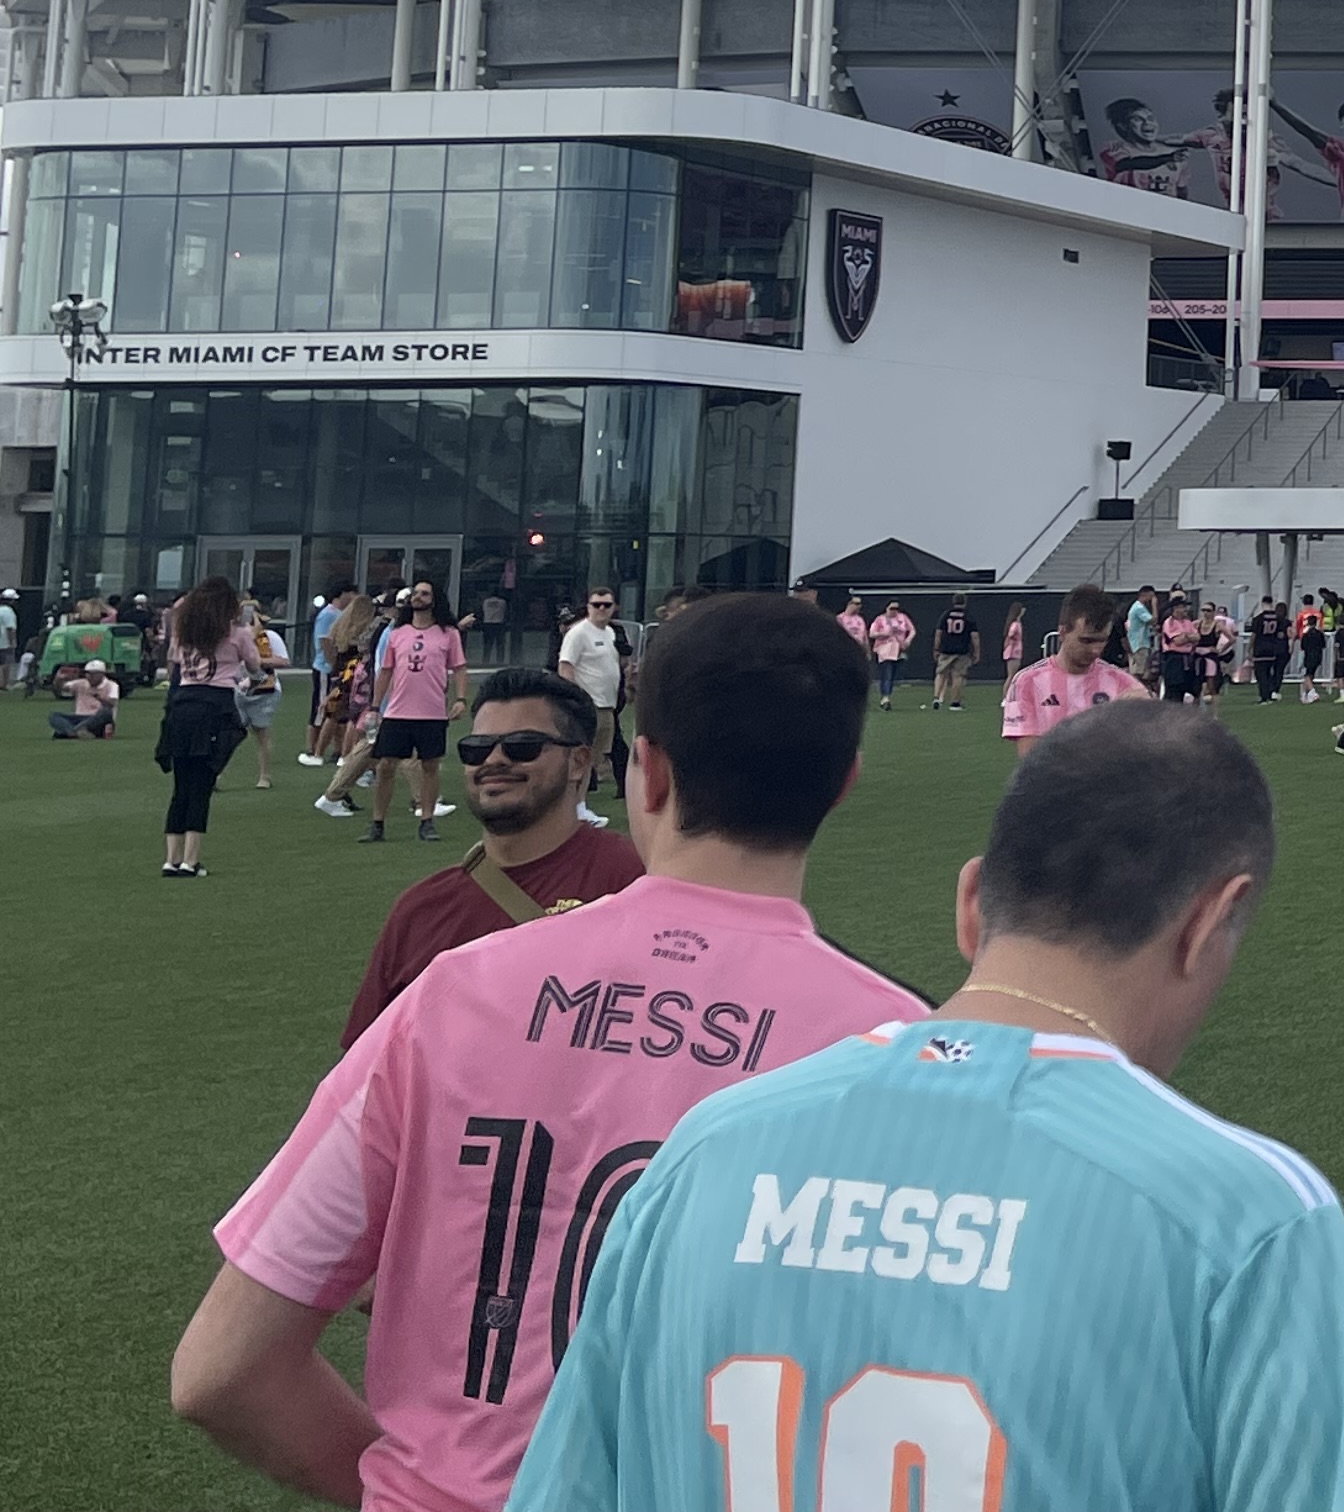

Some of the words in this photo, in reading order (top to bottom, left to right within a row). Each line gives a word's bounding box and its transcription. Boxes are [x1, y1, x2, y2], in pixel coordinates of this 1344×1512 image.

[841, 223, 877, 243] MIAMI
[1184, 304, 1227, 315] 205-20
[168, 346, 254, 365] MIAMI
[261, 345, 297, 364] CF
[303, 344, 385, 363] TEAM
[391, 343, 489, 362] STORE
[946, 617, 965, 634] 10
[1262, 620, 1277, 634] 10
[525, 974, 776, 1073] MESSI
[733, 1173, 1027, 1292] MESSI
